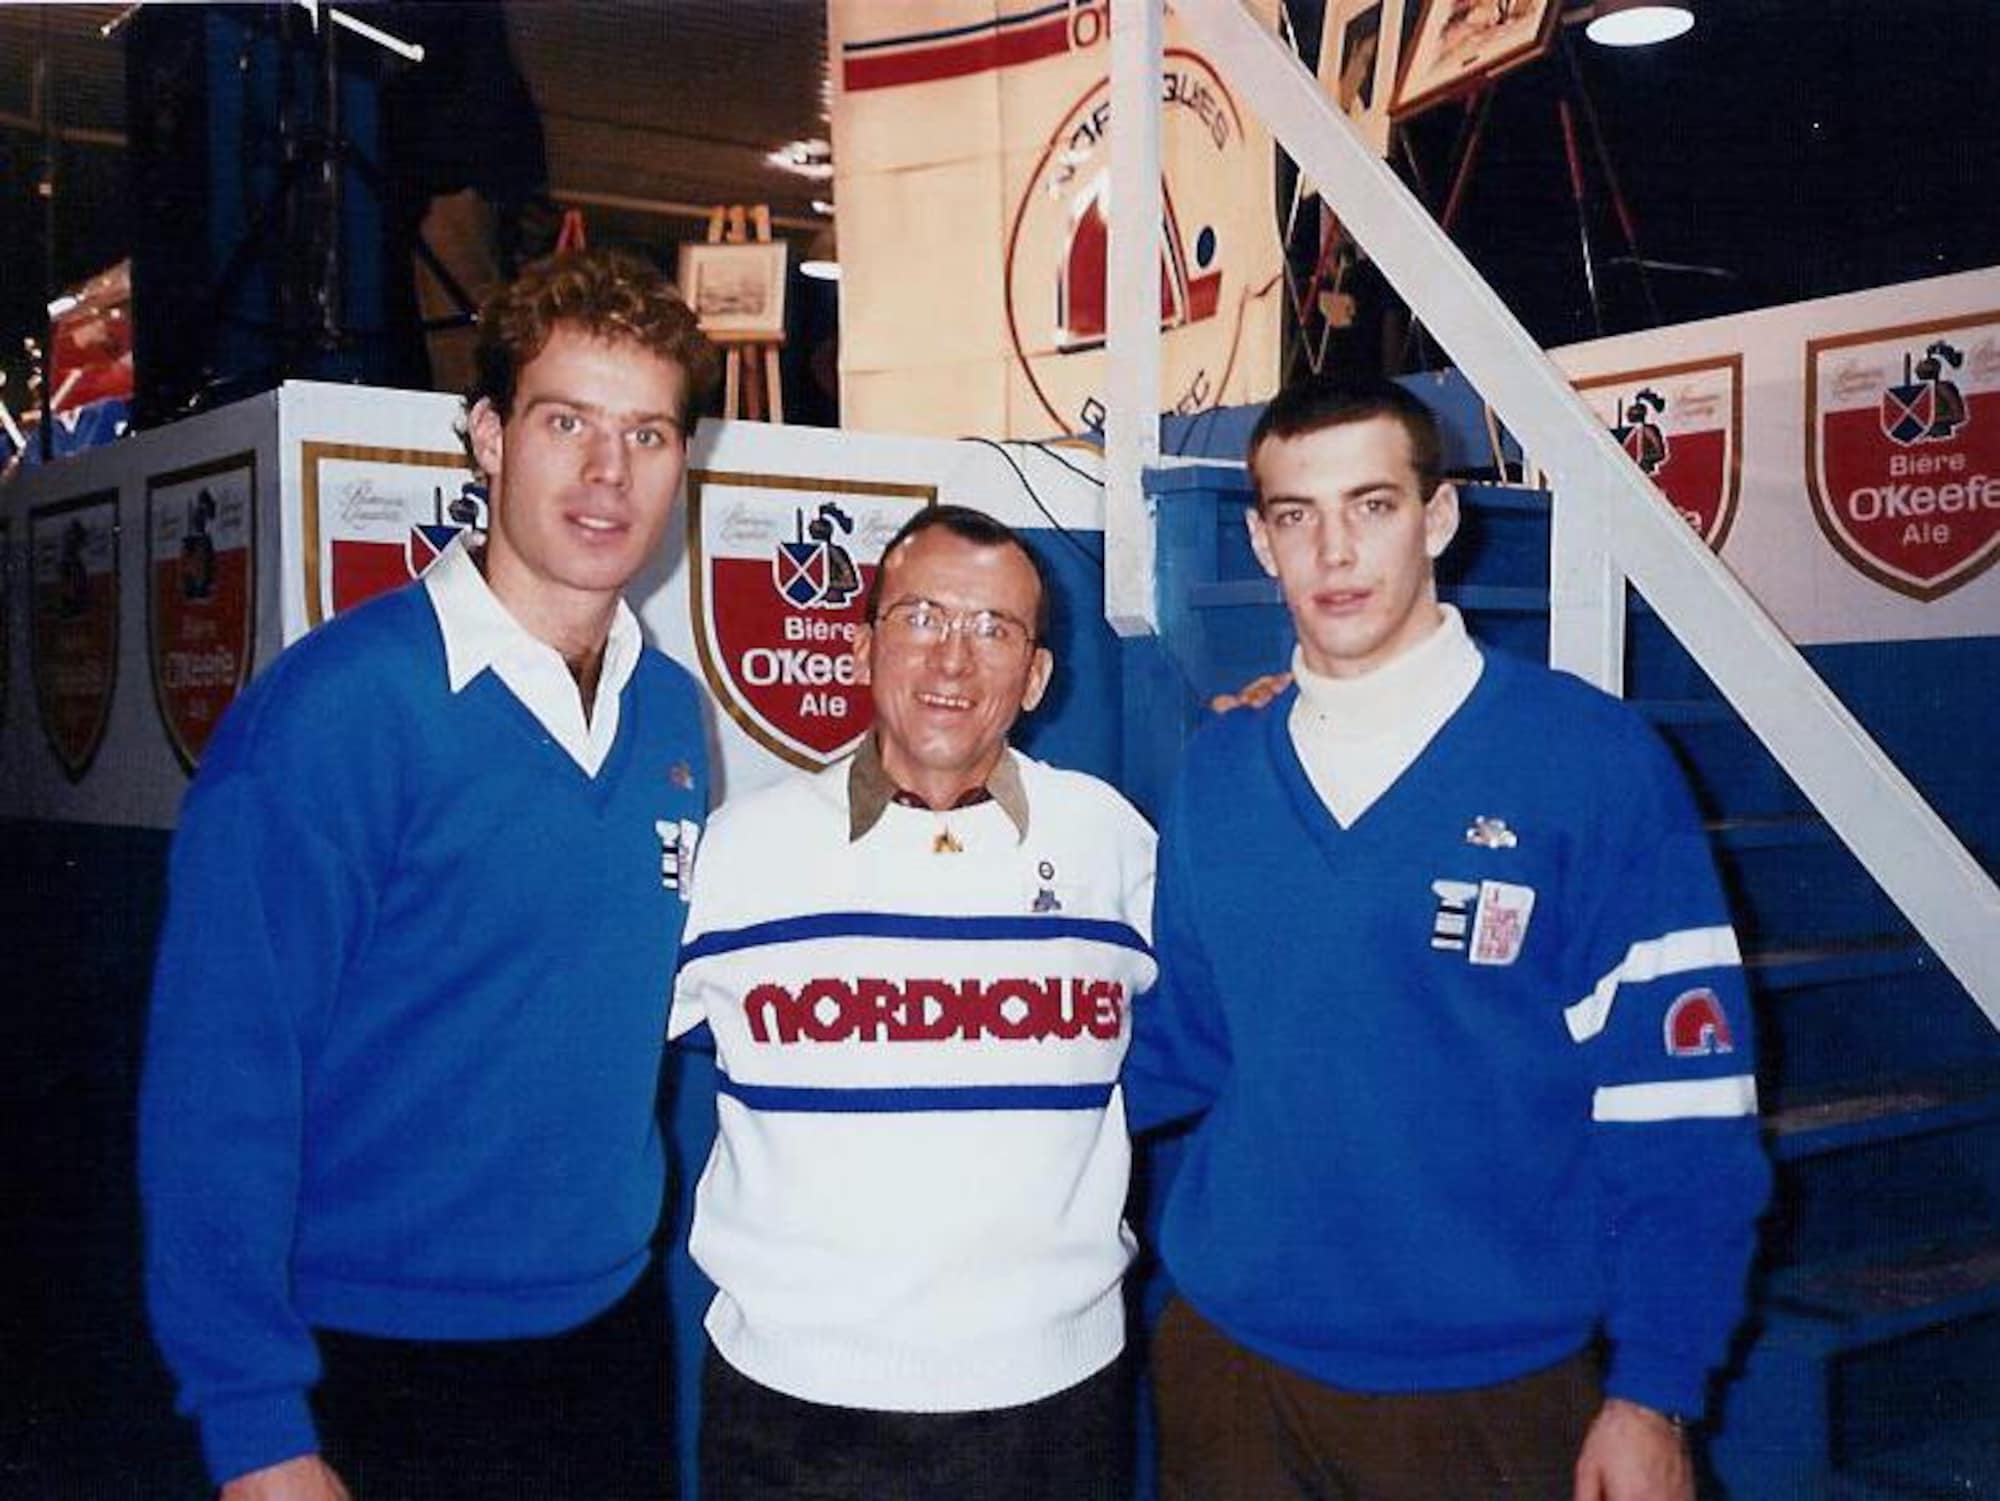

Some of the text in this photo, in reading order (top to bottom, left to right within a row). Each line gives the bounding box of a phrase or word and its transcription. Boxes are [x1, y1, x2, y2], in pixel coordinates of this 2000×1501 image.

[1902, 522, 1950, 545] Ale
[741, 648, 856, 686] O'Kee
[799, 692, 848, 717] Ale
